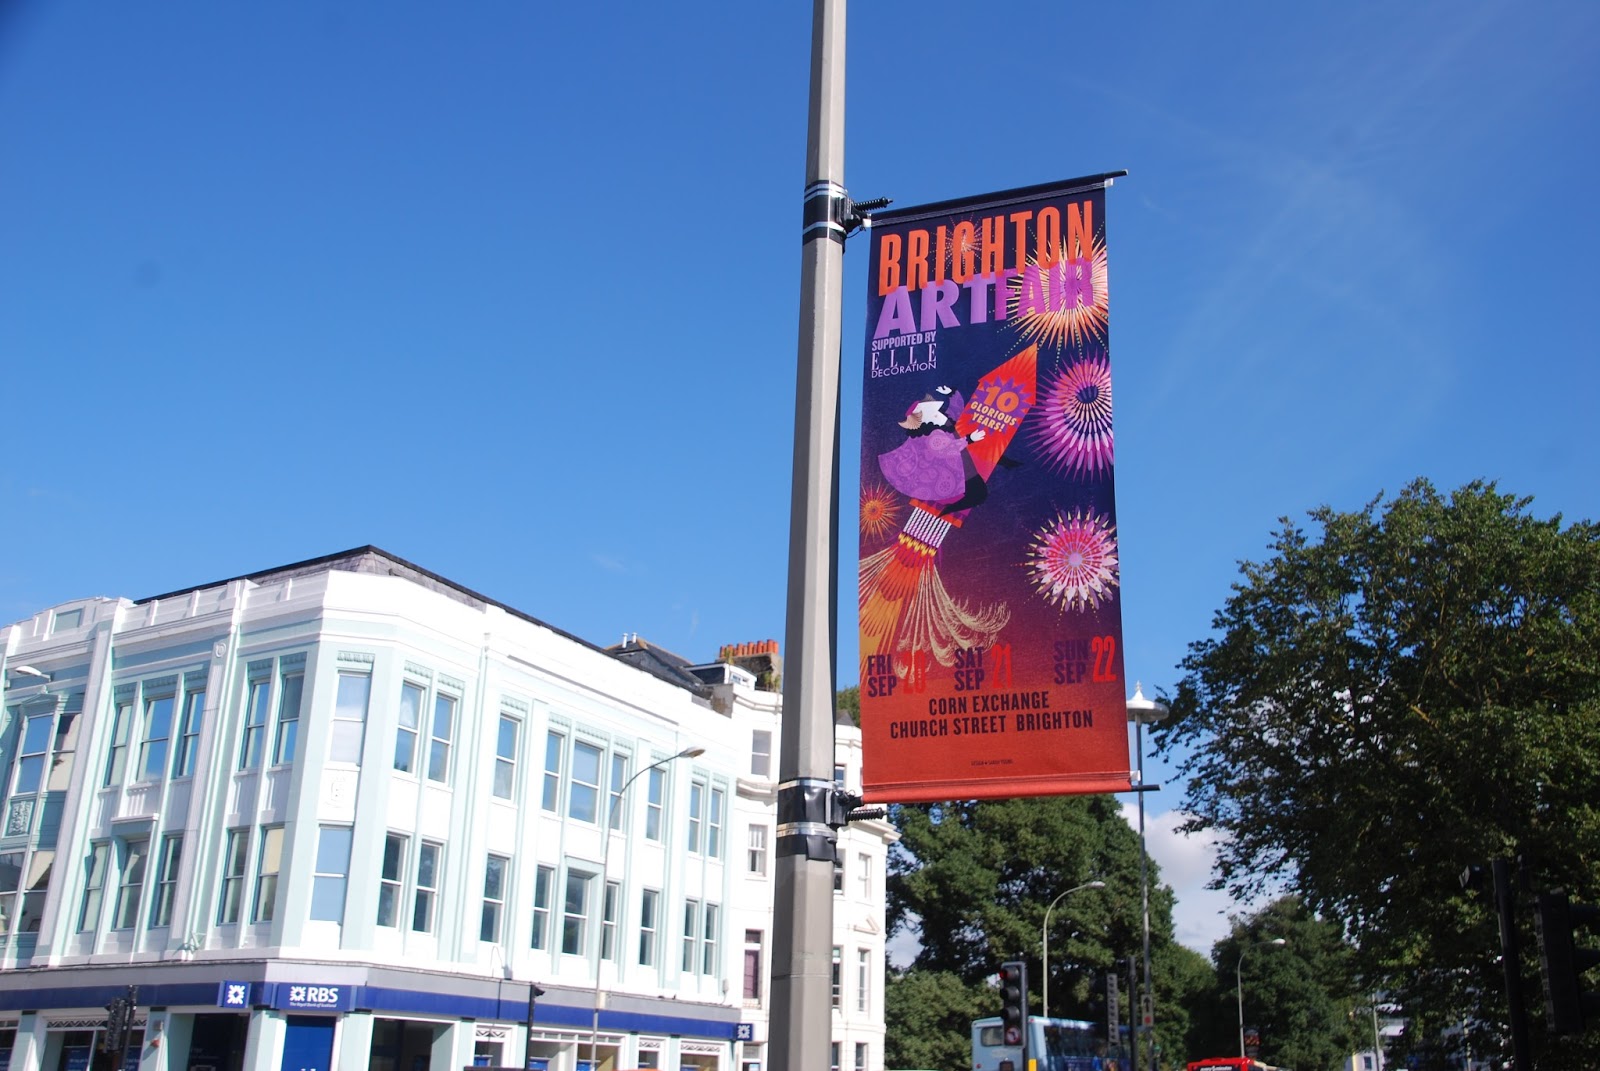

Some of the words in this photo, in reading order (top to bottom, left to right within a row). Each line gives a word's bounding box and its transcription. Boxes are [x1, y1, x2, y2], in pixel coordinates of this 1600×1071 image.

[879, 200, 1093, 297] BRIGHTON
[871, 333, 923, 351] SUPPORTED
[924, 331, 937, 343] BY
[872, 343, 937, 370] ELLE
[871, 361, 937, 378] DECORATION
[984, 386, 1020, 413] 10
[970, 401, 1017, 426] GLORIOUS
[972, 412, 1006, 432] YEARS!
[955, 646, 984, 669] SAT
[1053, 640, 1088, 661] SUN
[1091, 635, 1117, 683] 22
[868, 654, 892, 676] FRI
[902, 650, 926, 694] 20
[991, 643, 1012, 689] 21
[1054, 662, 1086, 685] SEP
[868, 676, 897, 697] SEP
[954, 668, 985, 691] SEP
[929, 697, 967, 716] CORN
[973, 691, 1050, 713] EXCHANGE
[890, 719, 948, 739] CHURCH
[953, 715, 1006, 735] STREET
[1016, 710, 1093, 732] BRIGHTON
[306, 987, 339, 1003] RBS
